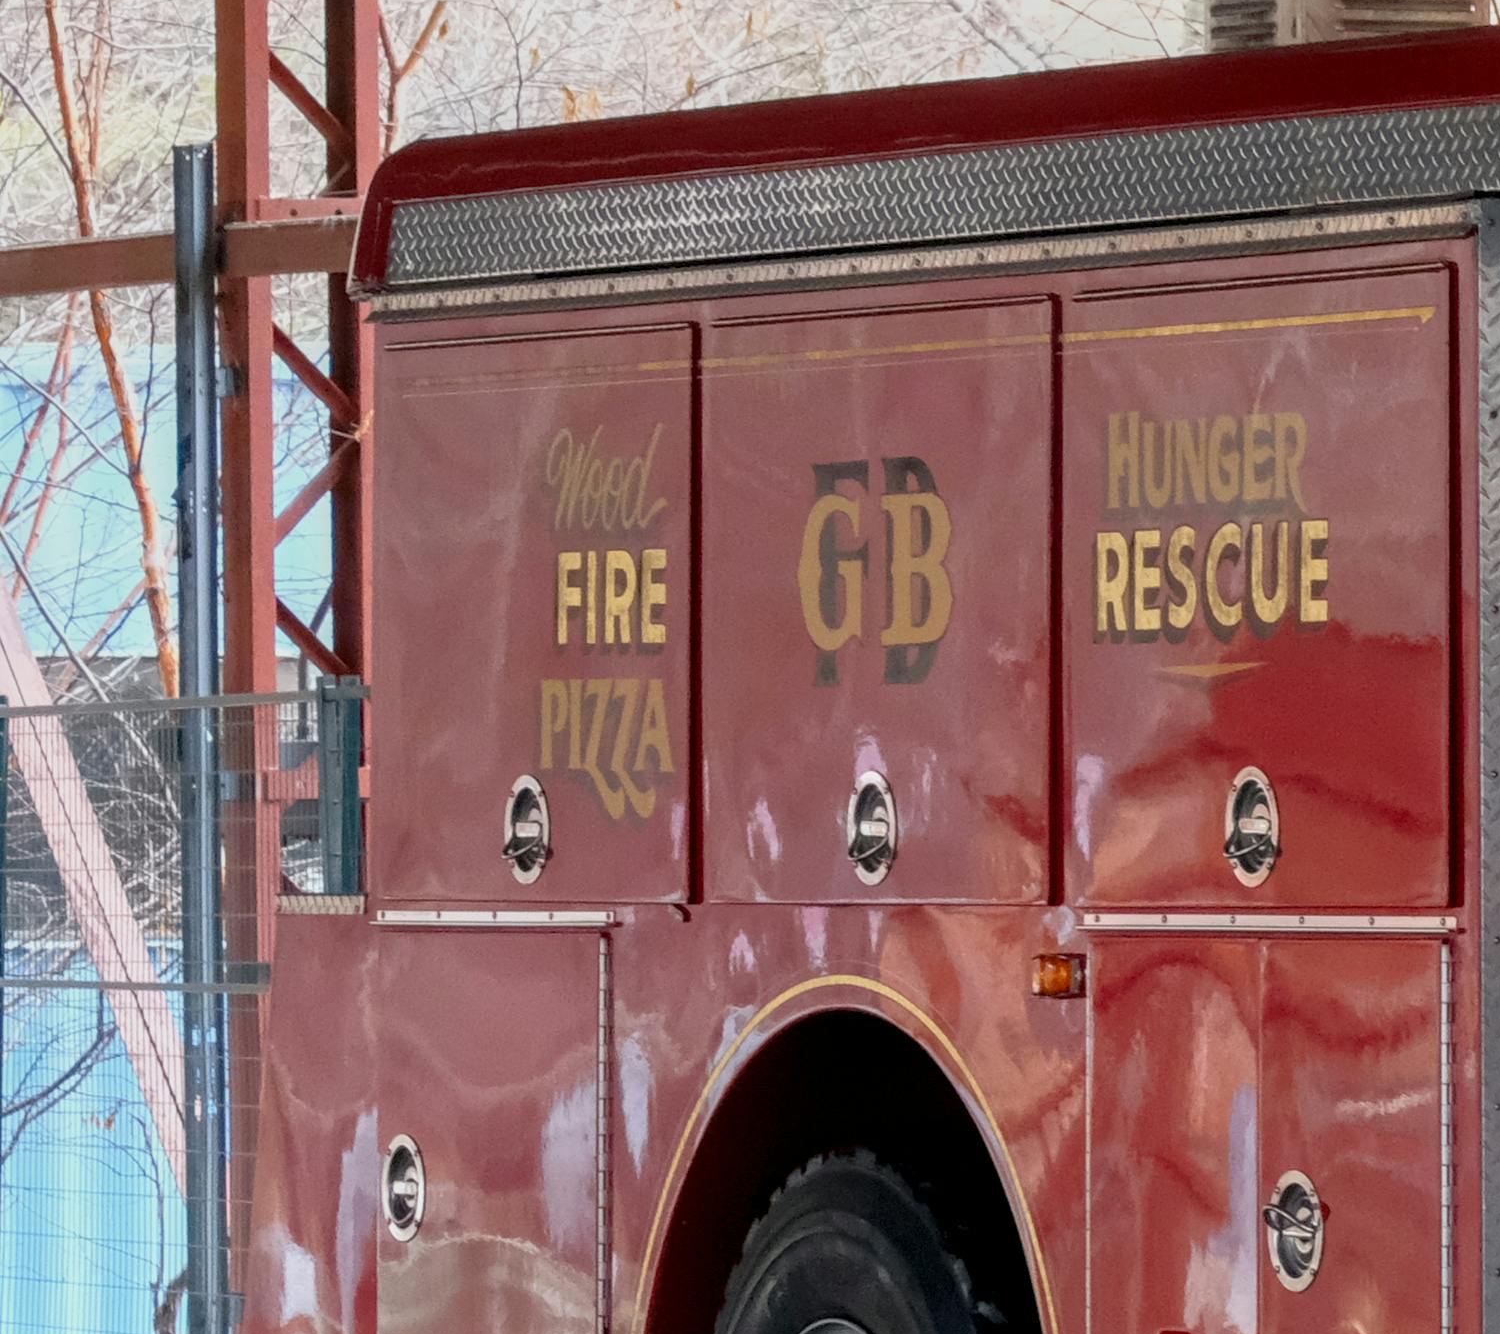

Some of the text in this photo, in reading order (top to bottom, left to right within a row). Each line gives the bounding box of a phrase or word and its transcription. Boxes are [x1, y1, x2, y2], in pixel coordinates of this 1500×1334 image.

[546, 423, 668, 531] Wood
[1107, 411, 1311, 513] HUNGER
[557, 549, 667, 645] FIRE
[798, 492, 954, 651] GB
[1097, 520, 1329, 632] RESCUE
[539, 679, 675, 820] PIZZA
